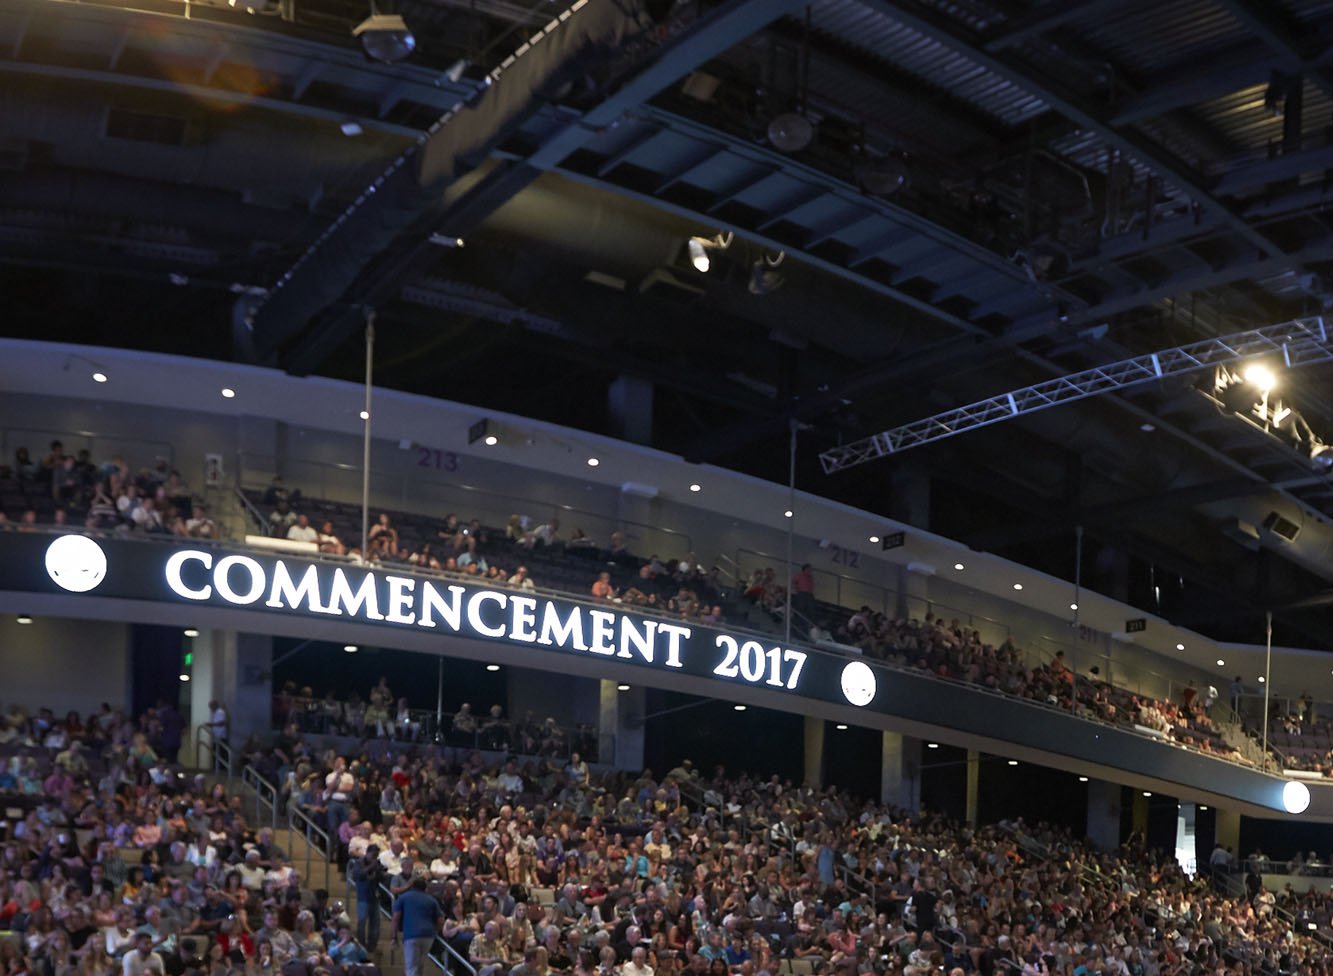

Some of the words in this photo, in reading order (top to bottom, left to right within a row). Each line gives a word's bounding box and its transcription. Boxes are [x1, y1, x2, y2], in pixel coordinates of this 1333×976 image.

[416, 447, 459, 473] 213
[831, 545, 861, 569] 212
[165, 549, 692, 668] COMMENCEMENT
[713, 634, 808, 690] 2017
